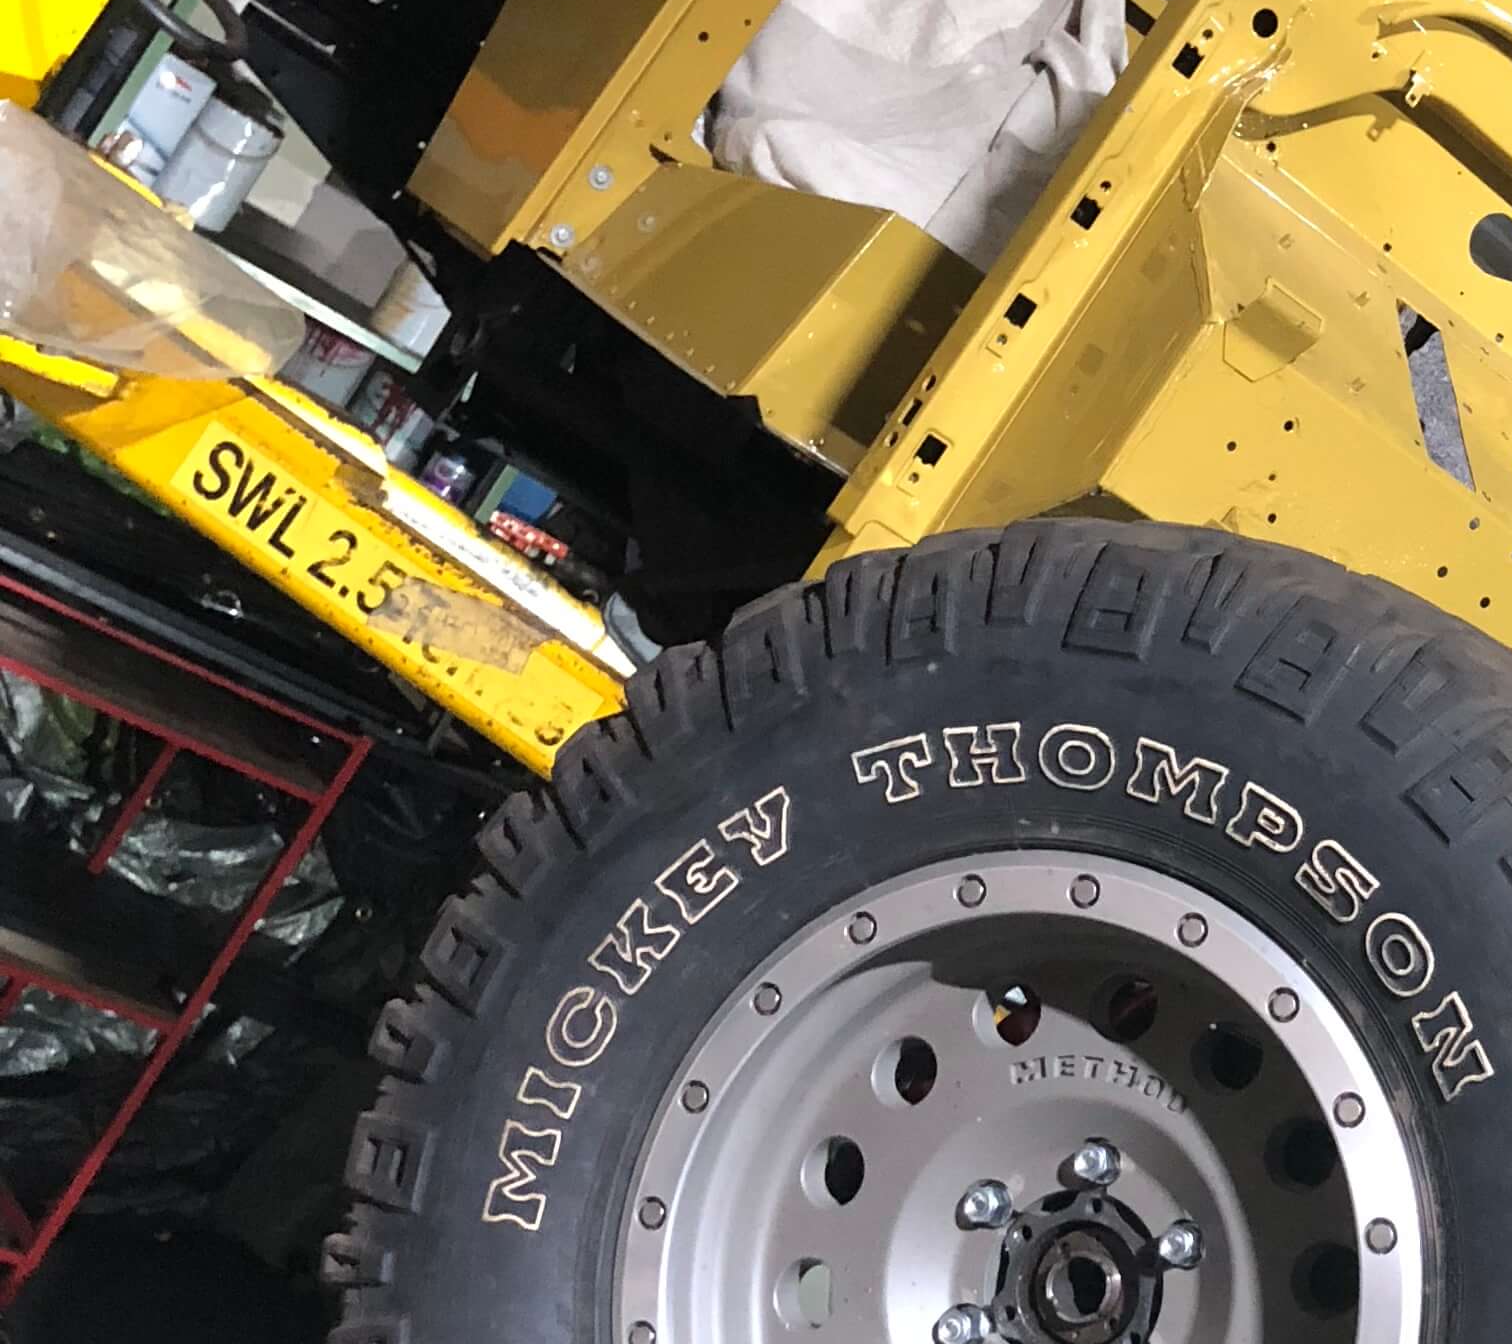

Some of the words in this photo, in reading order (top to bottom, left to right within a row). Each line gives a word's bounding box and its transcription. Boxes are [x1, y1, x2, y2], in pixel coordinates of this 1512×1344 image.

[193, 440, 308, 559] SWL
[306, 529, 407, 615] 2.5
[482, 786, 790, 1231] MICKEY
[851, 721, 1495, 1103] THOMPSON
[1008, 1054, 1187, 1116] METHOD
